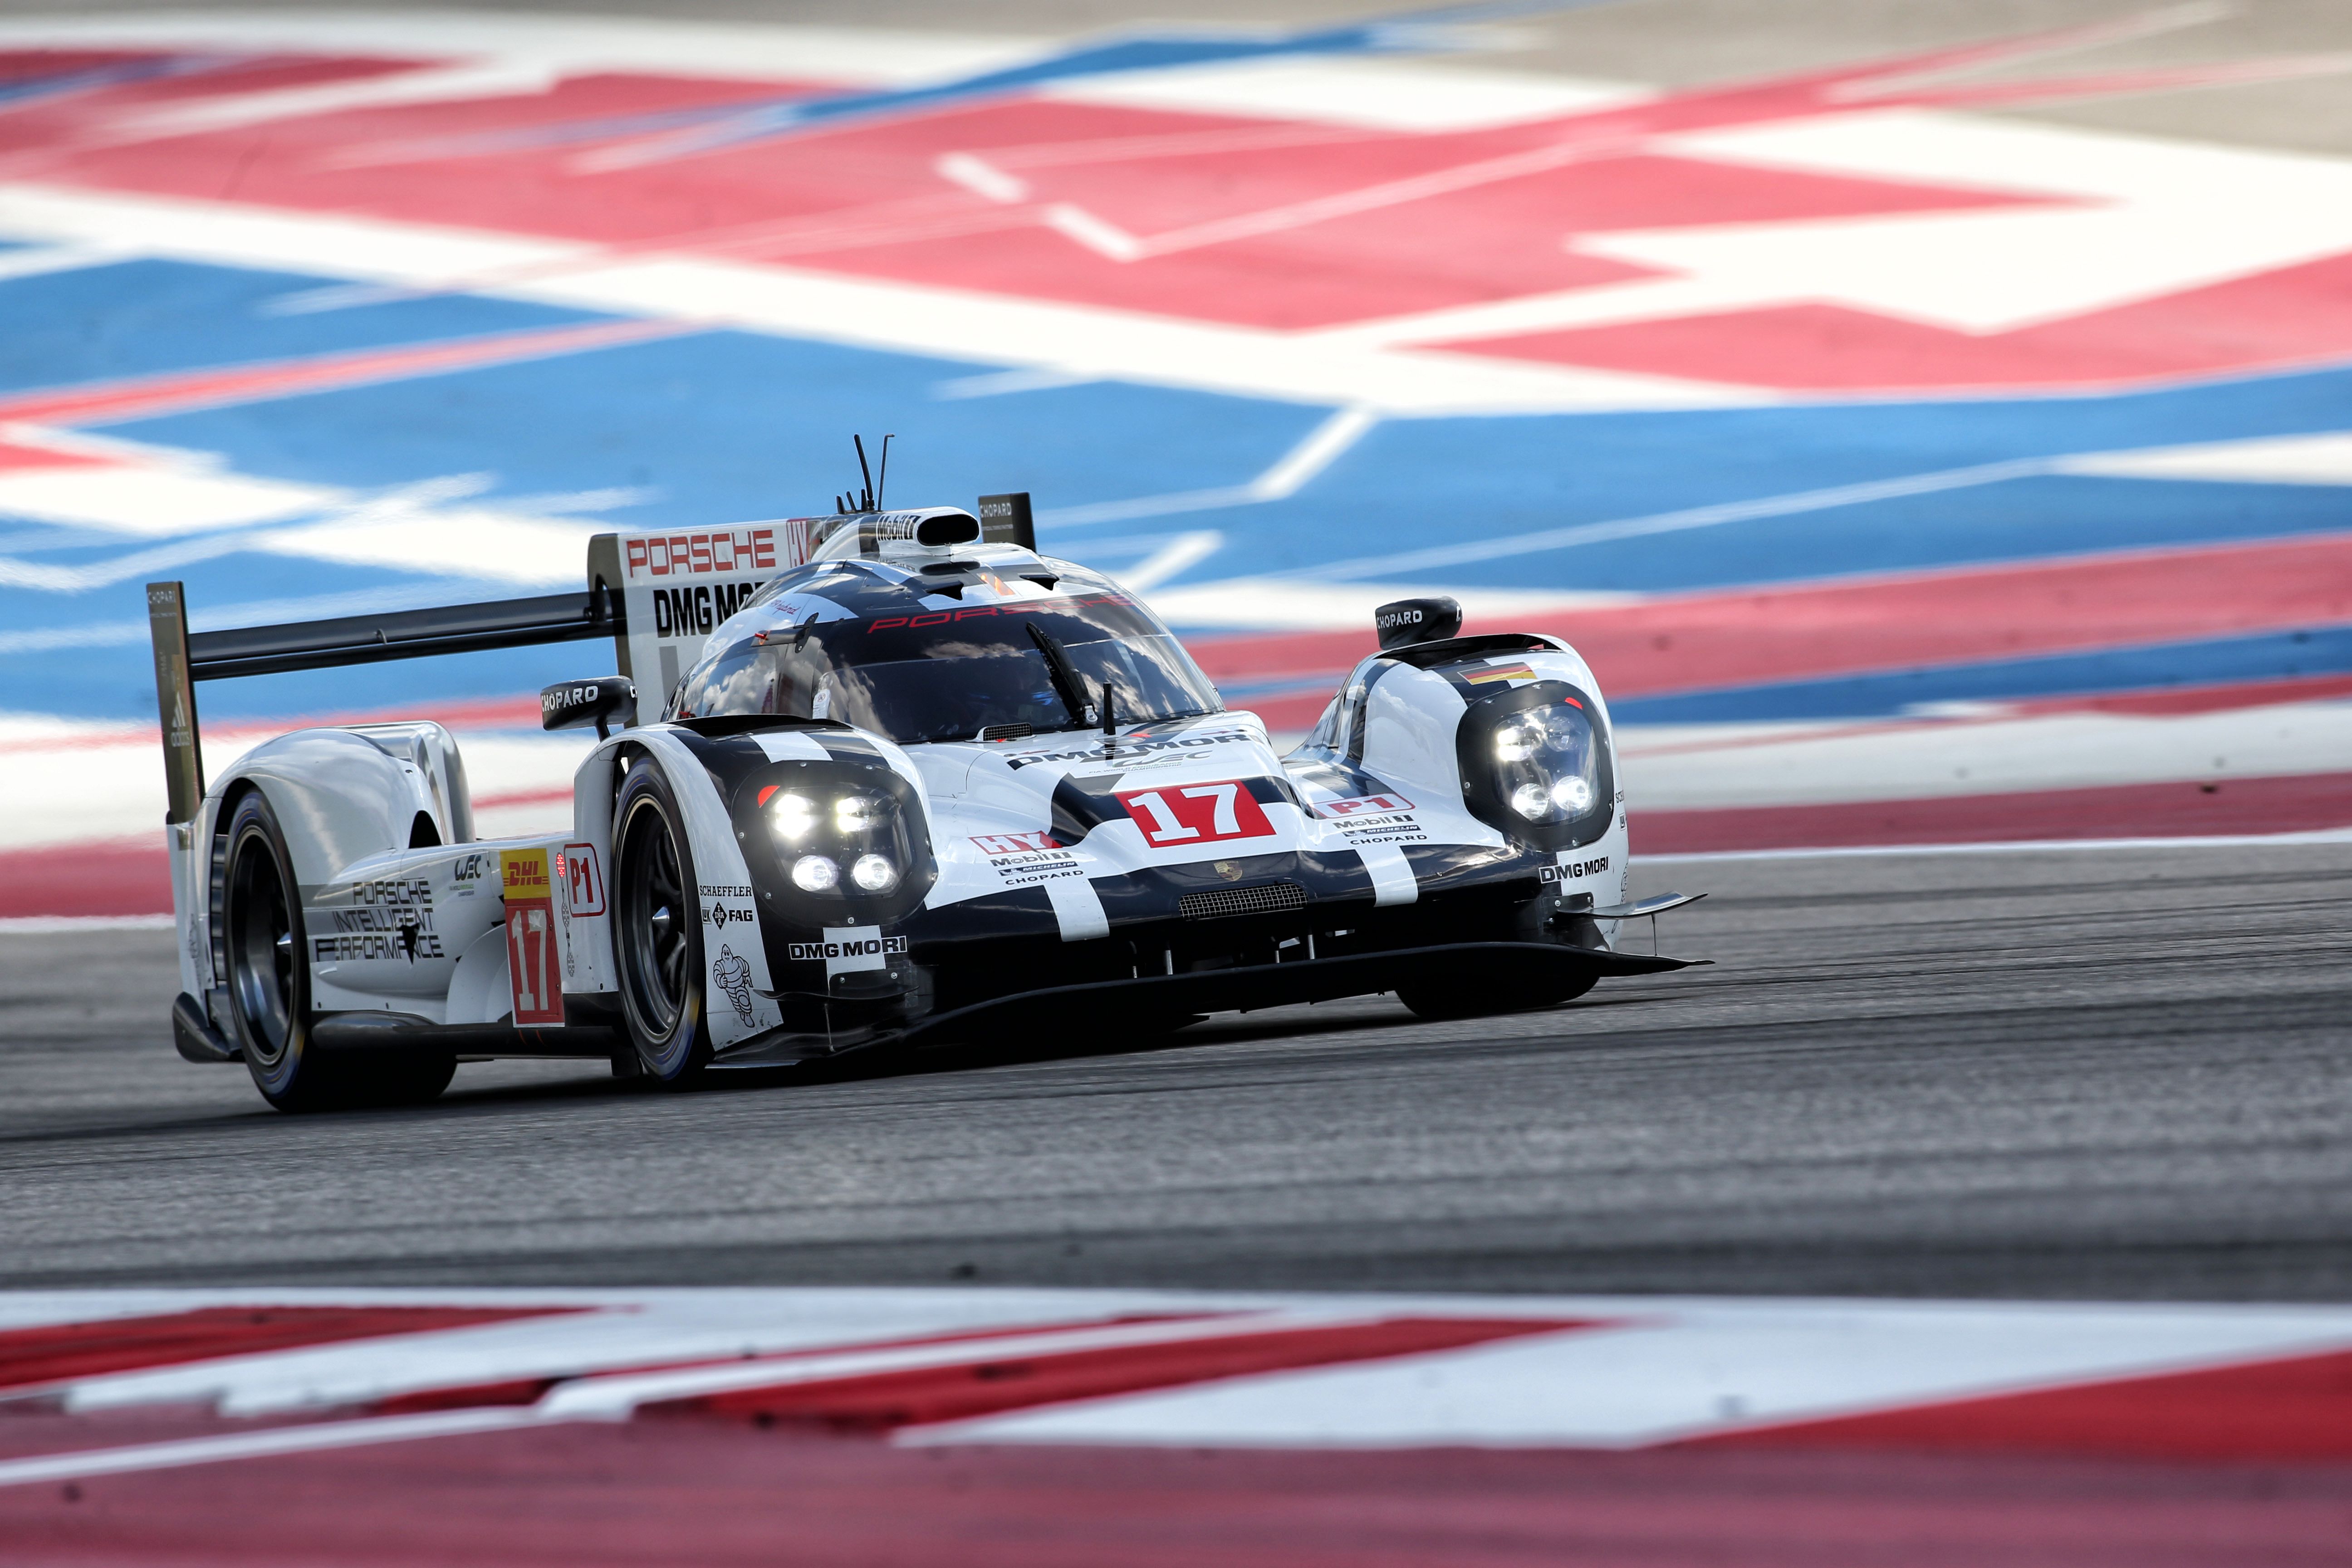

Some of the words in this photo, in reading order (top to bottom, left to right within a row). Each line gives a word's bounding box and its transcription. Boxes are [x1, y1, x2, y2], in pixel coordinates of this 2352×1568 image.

[980, 502, 1012, 518] CHOPARD
[877, 515, 906, 541] Mobil
[627, 529, 776, 578] PORSCHE
[654, 587, 712, 638] DMG
[867, 594, 1136, 634] PORSCHE
[1377, 610, 1422, 629] CHOPARD
[541, 686, 598, 712] CHOPARD
[1007, 743, 1126, 770] DMG
[1112, 750, 1213, 767] WEC
[1128, 784, 1241, 842] 17
[1327, 797, 1395, 814] P1
[1333, 816, 1392, 829] Mobil
[972, 833, 1048, 853] HY
[1350, 835, 1428, 845] CHOPARD
[455, 855, 481, 881] WEC
[990, 853, 1049, 867] Mobil
[1022, 862, 1075, 872] MICHELIN
[1541, 863, 1583, 882] DMG
[1584, 856, 1609, 876] MORI
[508, 861, 542, 886] DHL
[569, 858, 593, 904] P1
[1005, 870, 1084, 885] CHOPARD
[353, 881, 432, 905] PORSCHE
[699, 885, 752, 897] SCHAEFFLER
[333, 907, 433, 933] INTELLIGENT
[729, 910, 753, 921] FAG
[511, 910, 549, 1010] 17
[790, 944, 839, 959] DMG
[843, 937, 906, 957] MORI
